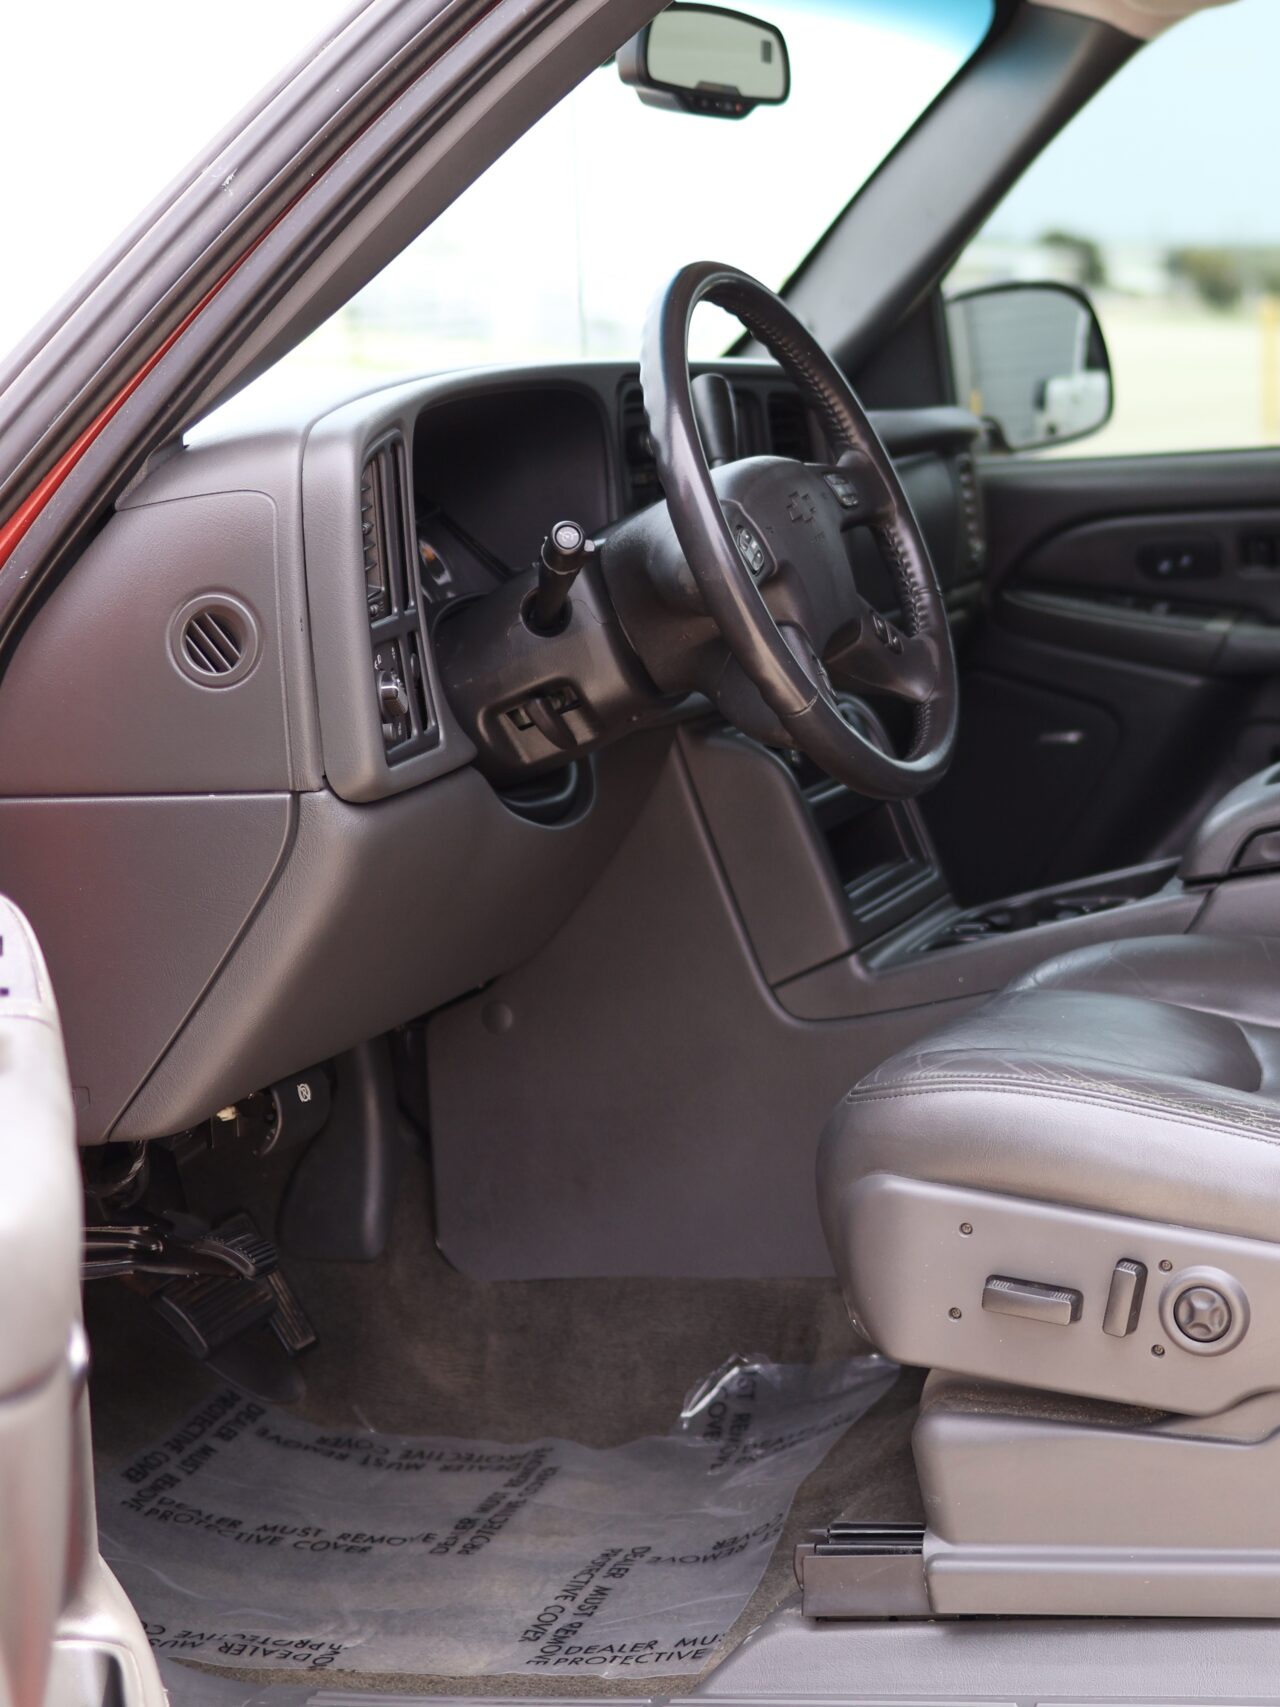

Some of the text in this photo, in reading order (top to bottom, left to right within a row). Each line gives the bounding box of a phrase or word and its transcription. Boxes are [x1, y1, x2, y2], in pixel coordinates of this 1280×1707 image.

[359, 1454, 426, 1473] MUST
[144, 1507, 373, 1555] PROTECTIVE COVER
[156, 1497, 440, 1546] DEALER MUST REMOVE
[518, 1547, 624, 1643] PROTECTIVE COVER
[526, 1545, 652, 1666] DEALER MUST REMOVE
[149, 1637, 205, 1649] MUS
[174, 1629, 328, 1651] PROTECTIVE
[218, 1640, 312, 1663] DEALER
[564, 1633, 726, 1656] DEALER MU
[549, 1648, 709, 1667] PROTECTIVE
